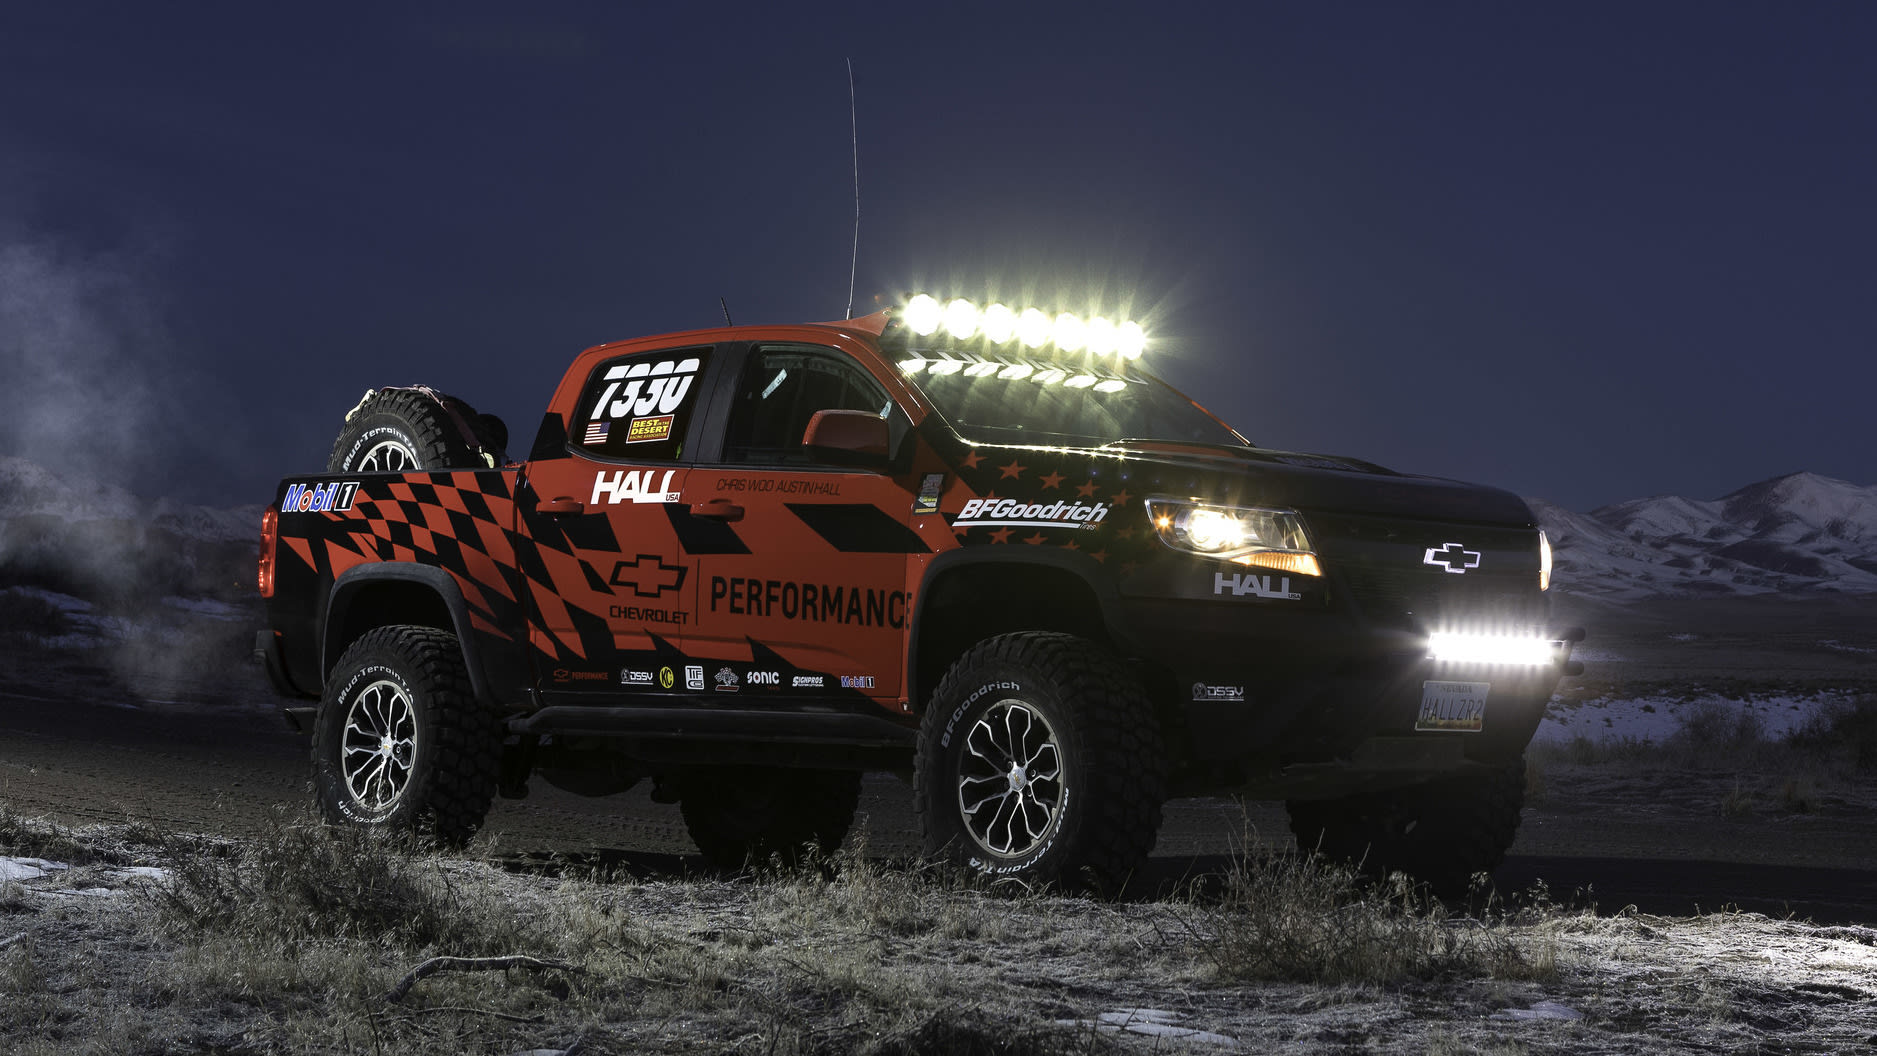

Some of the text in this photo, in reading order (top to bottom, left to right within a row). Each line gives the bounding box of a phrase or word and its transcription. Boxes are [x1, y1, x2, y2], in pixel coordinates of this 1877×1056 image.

[590, 358, 700, 420] 7330
[630, 425, 669, 436] DESERT
[632, 419, 660, 429] BEST
[342, 426, 402, 473] Mud-Terrain
[281, 481, 340, 513] Mobil
[590, 470, 680, 504] HALL
[665, 493, 680, 502] USA
[716, 478, 746, 492] CHRIS
[775, 479, 815, 496] AUSTIN
[814, 481, 842, 496] HALL
[957, 498, 1109, 523] BFGoodrich
[1214, 572, 1290, 599] HALL
[1288, 592, 1301, 600] USA
[609, 604, 689, 626] CHEVROLET
[337, 664, 401, 705] Mud-Terrain
[660, 667, 673, 688] KC
[840, 675, 866, 689] Mobil
[1207, 686, 1244, 696] DSSV
[941, 681, 1020, 748] BFGoodrich
[1421, 697, 1484, 721] HALLZR2
